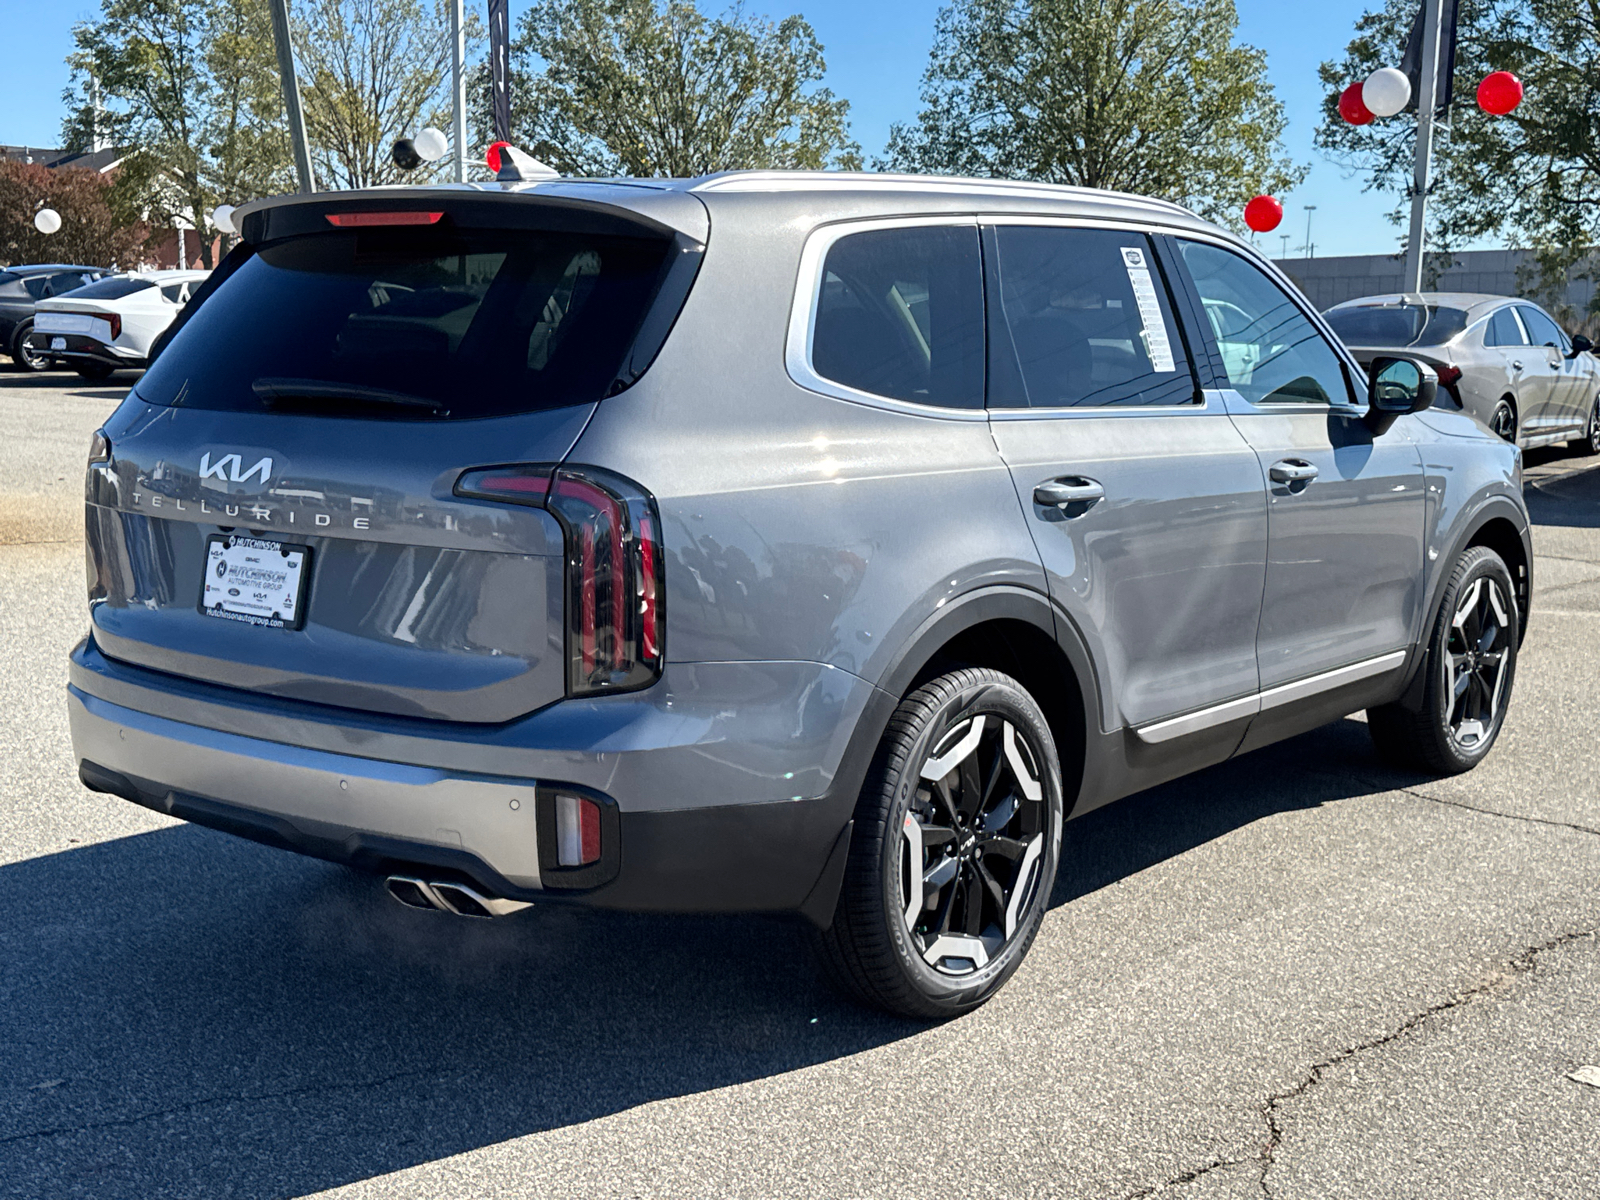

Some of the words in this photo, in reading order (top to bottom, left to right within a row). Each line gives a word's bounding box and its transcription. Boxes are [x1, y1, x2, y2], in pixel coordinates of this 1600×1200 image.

[199, 452, 273, 485] KIA
[132, 492, 370, 530] TELLURIDE
[236, 537, 282, 551] HUTCHINSON
[228, 567, 288, 583] HUTCHINSON
[228, 577, 262, 589] AUTOMOTIVE
[262, 581, 283, 591] GROUP
[206, 608, 284, 627] Hutchinsonautogroup.com
